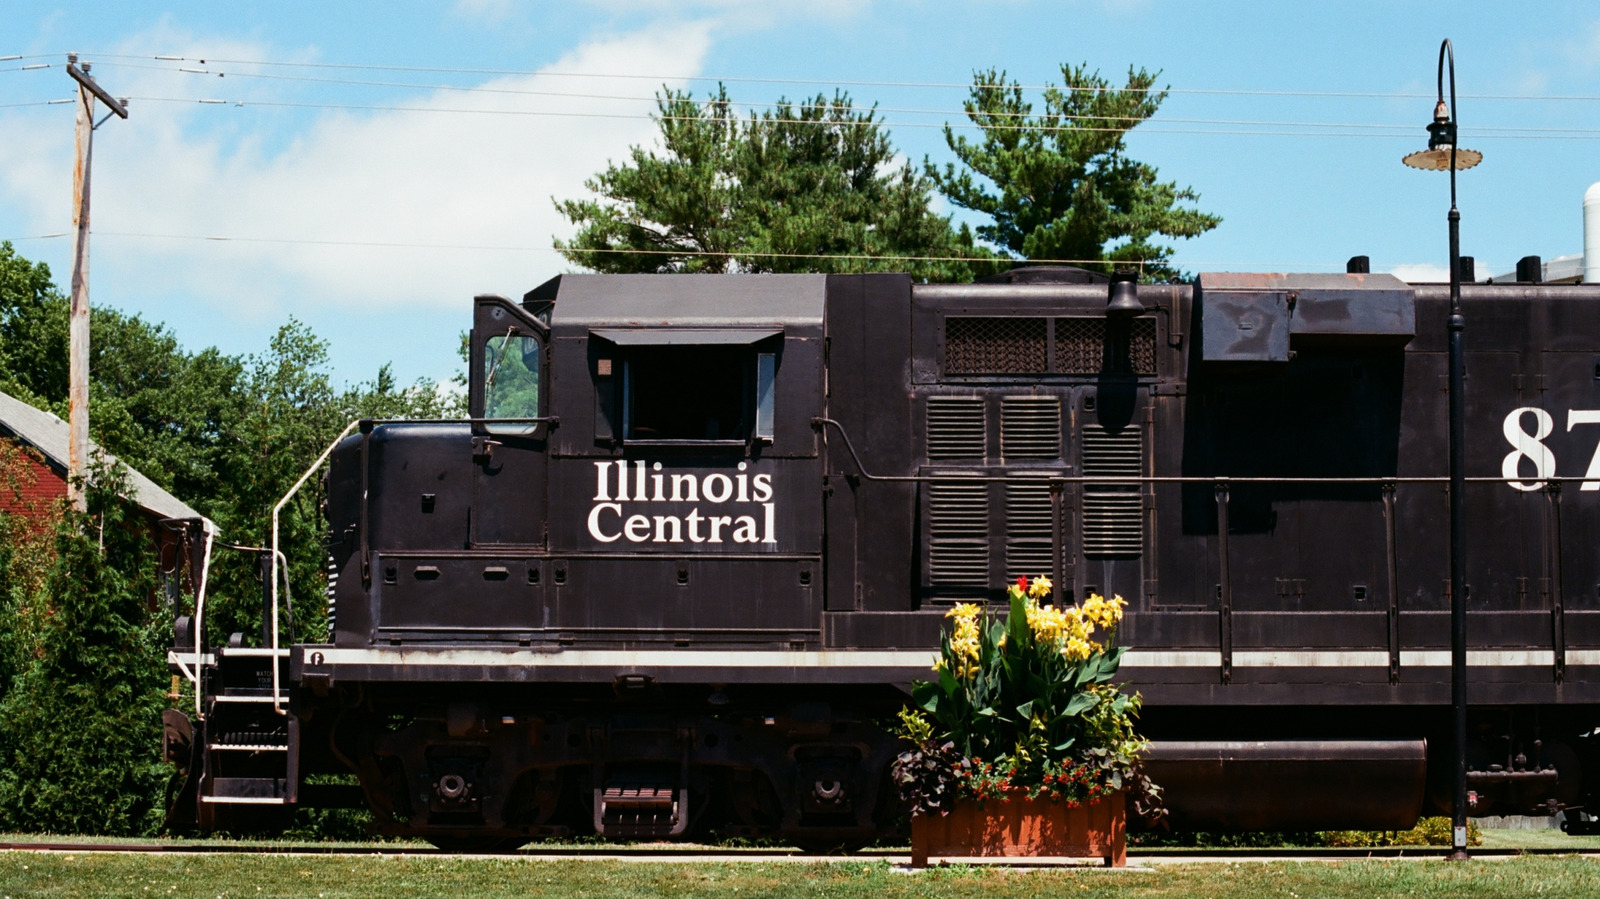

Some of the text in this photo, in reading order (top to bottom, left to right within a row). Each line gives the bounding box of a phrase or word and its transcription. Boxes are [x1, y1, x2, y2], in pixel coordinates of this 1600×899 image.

[592, 459, 774, 503] Illinois
[587, 502, 778, 543] Central
[314, 653, 320, 665] F
